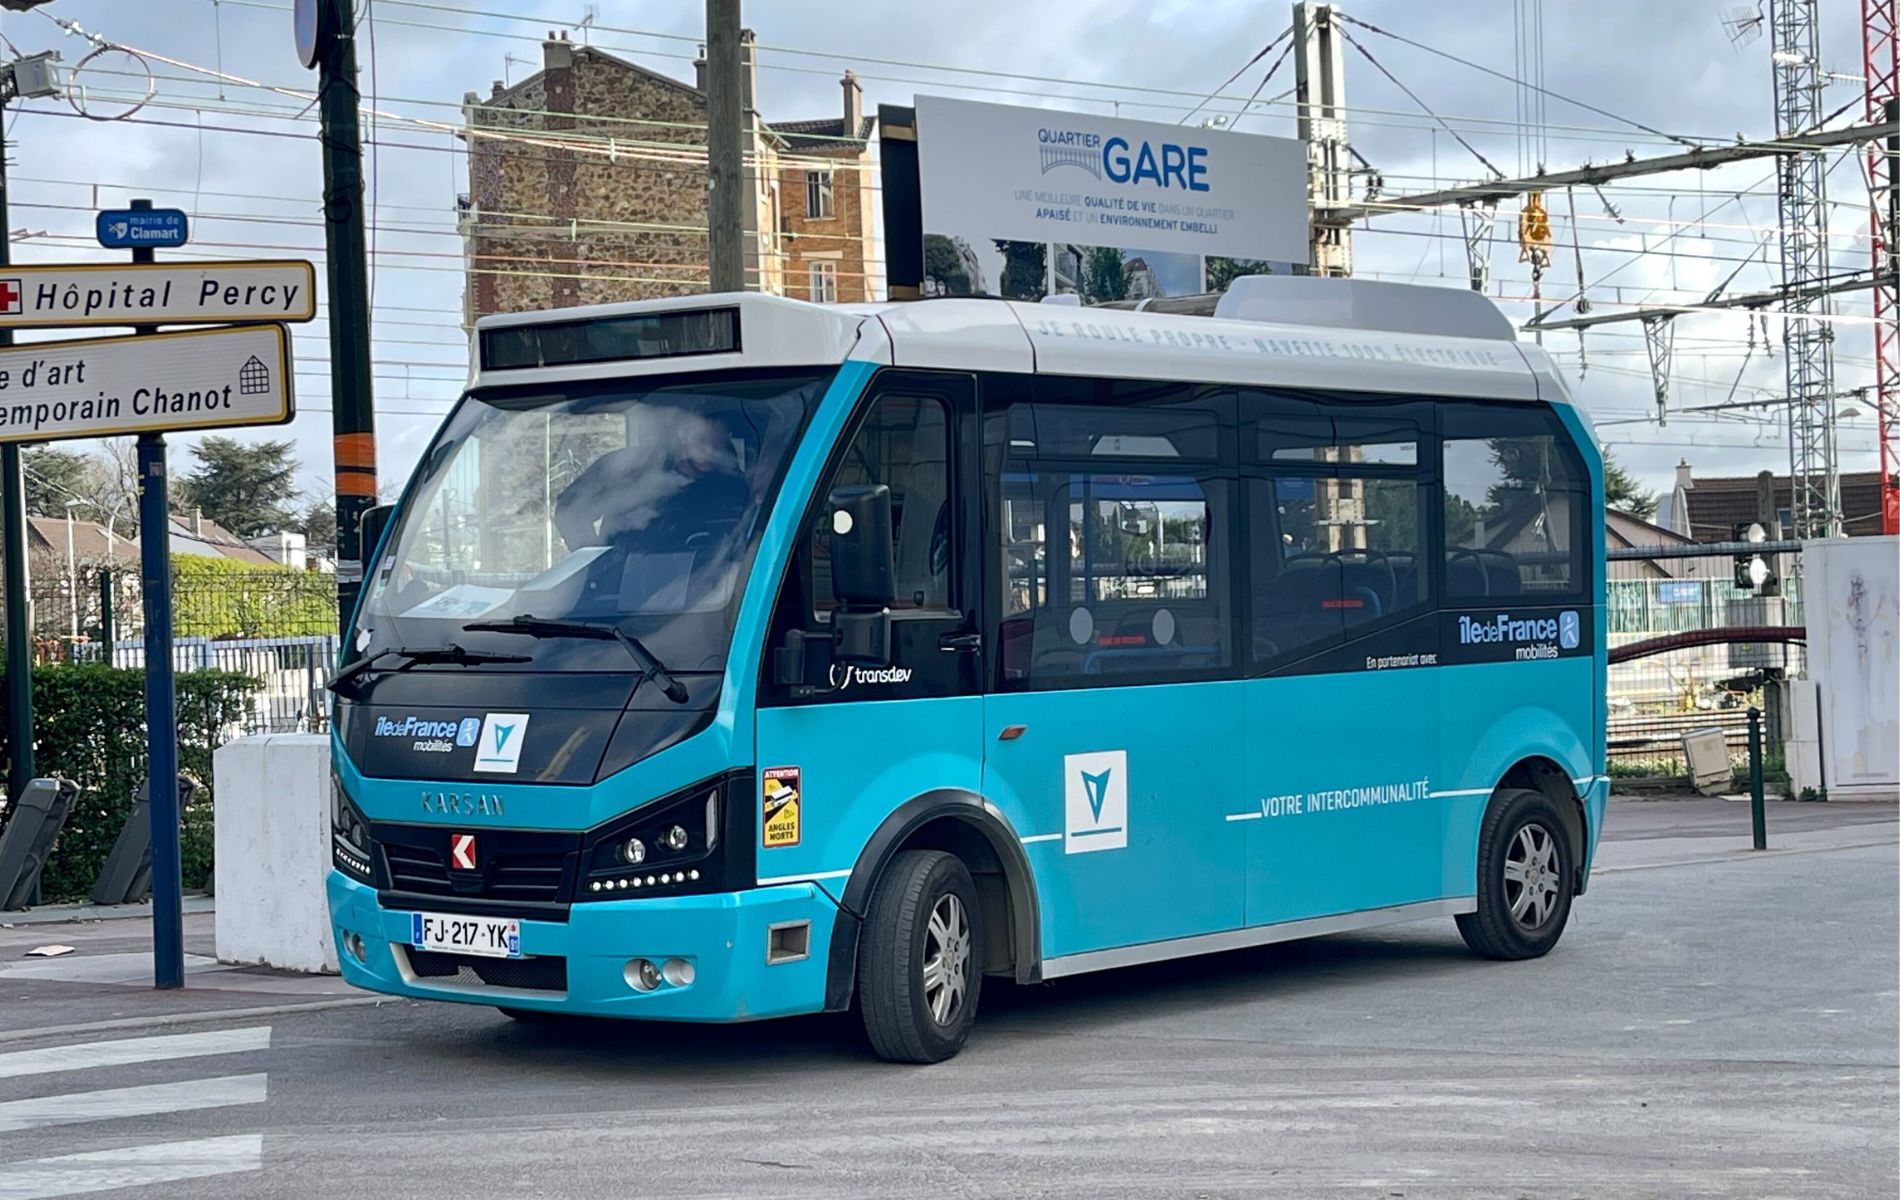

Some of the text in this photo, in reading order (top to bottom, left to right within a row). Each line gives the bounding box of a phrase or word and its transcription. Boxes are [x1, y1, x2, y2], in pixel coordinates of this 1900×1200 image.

[1038, 128, 1100, 148] QUARTIER
[1103, 137, 1210, 192] GARE
[1084, 196, 1124, 210] QUALITÉ
[1126, 201, 1139, 211] DE
[1141, 202, 1156, 213] VIE
[130, 215, 179, 225] mairie de
[1036, 208, 1071, 221] APAISÉ
[1100, 214, 1178, 231] ENVIRONNEMENT
[1180, 223, 1217, 234] EMBELLI
[131, 227, 179, 239] Clamart
[35, 280, 298, 316] Hôpital Percy
[132, 385, 231, 415] Chanot
[1515, 643, 1559, 660] mobilités
[1366, 653, 1438, 670] En partenariat avec
[855, 666, 912, 684] transdev
[413, 739, 453, 753] mobilités
[421, 792, 504, 816] KARSAN
[1261, 776, 1429, 817] VOTRE INTERCOMMUNALITÉ
[768, 821, 796, 832] ANGLES
[769, 831, 795, 841] MORTS
